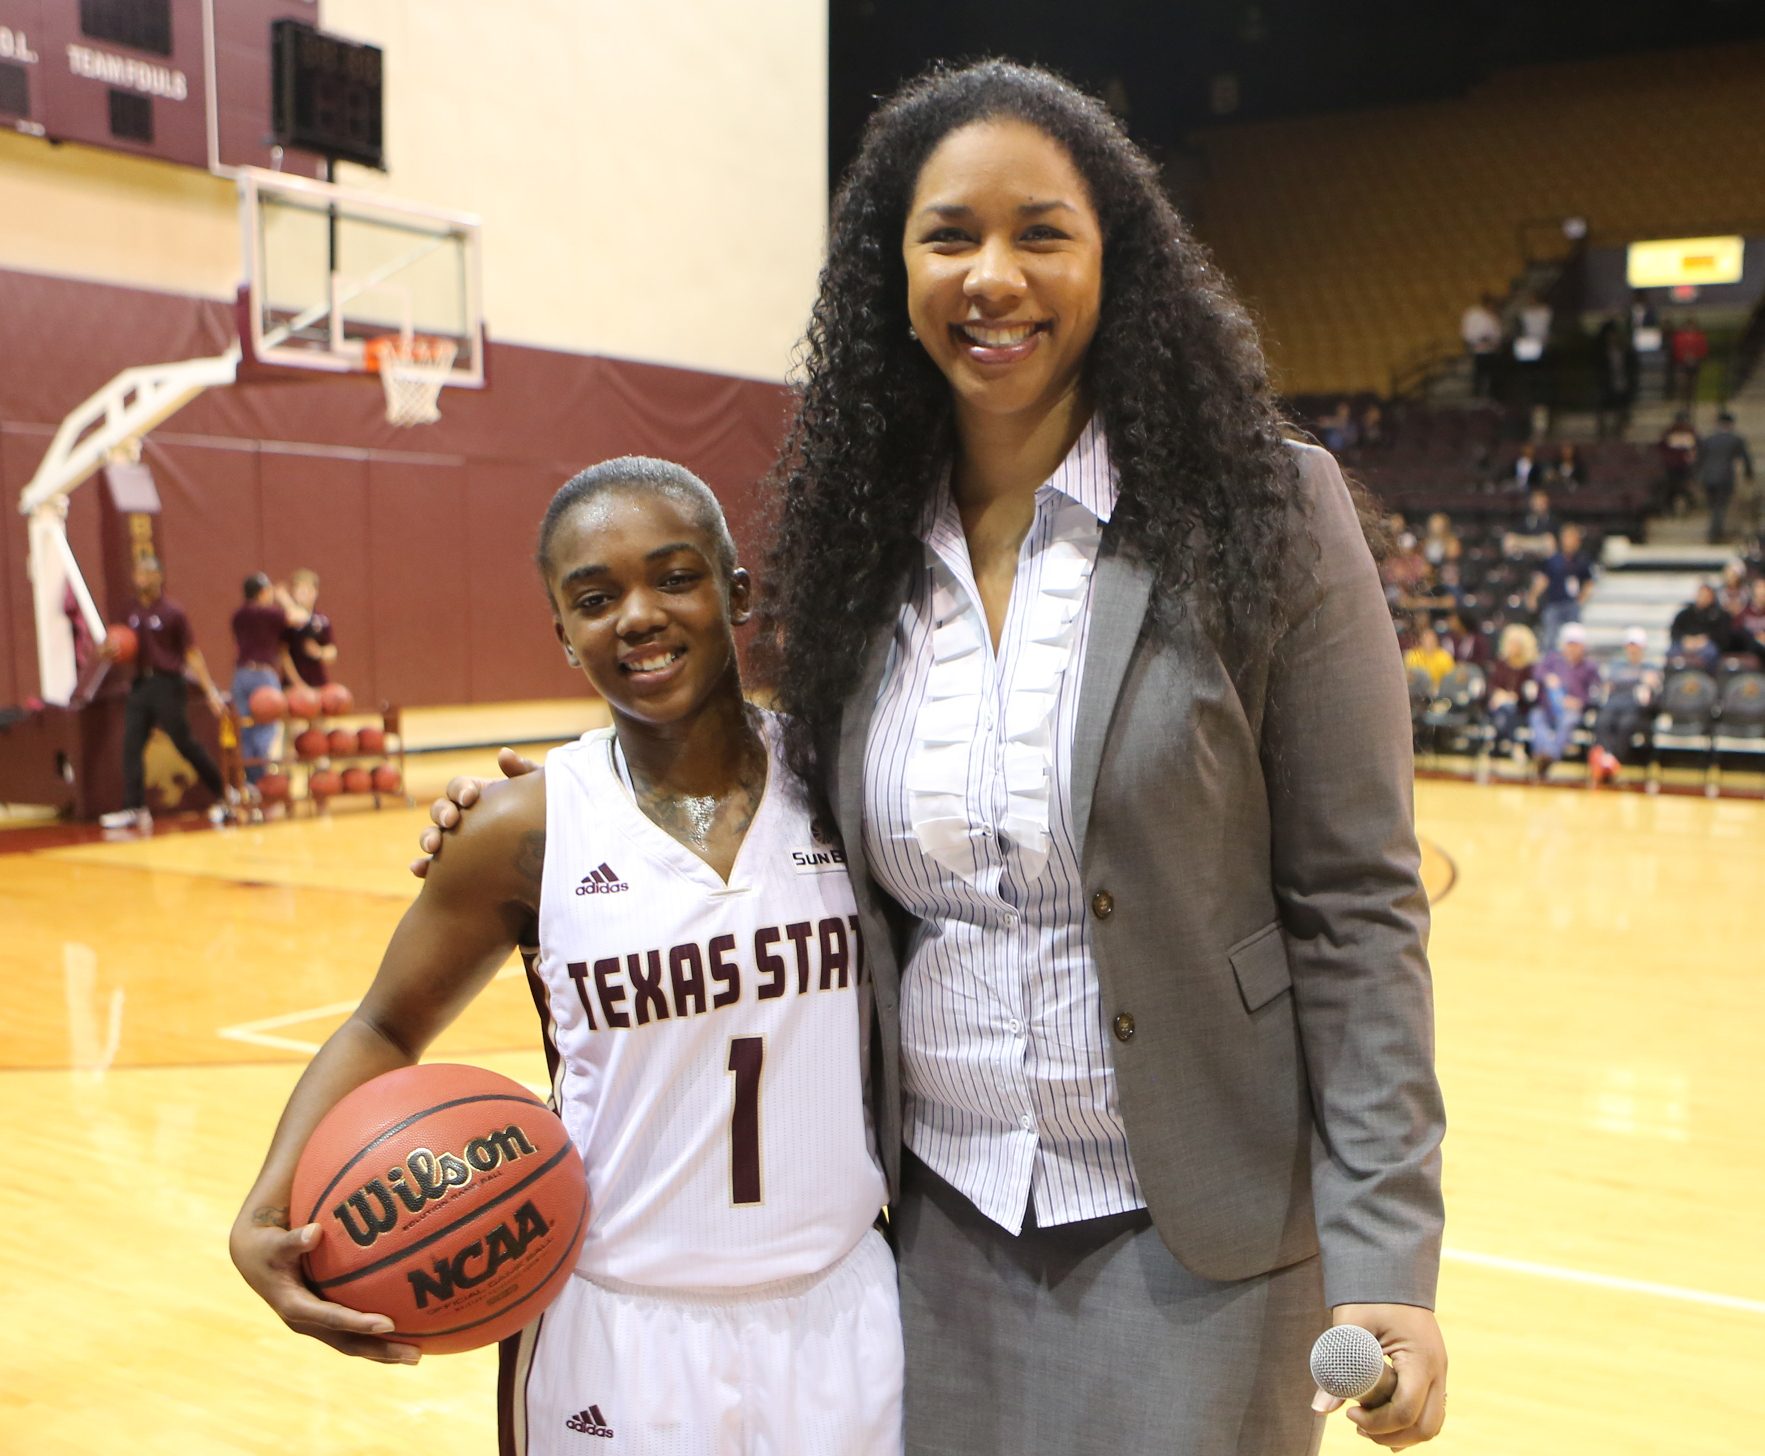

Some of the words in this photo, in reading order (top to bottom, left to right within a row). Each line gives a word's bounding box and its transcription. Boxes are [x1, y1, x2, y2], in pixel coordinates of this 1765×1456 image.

[67, 44, 125, 85] TEAM
[125, 58, 188, 101] FOULS
[575, 881, 629, 896] adidas
[567, 933, 741, 1031] TEXAS
[754, 914, 866, 1001] STAT
[725, 1034, 767, 1208] 1
[333, 1125, 538, 1247] Wilson
[407, 1200, 550, 1309] NCAA
[565, 1420, 614, 1438] adidas
